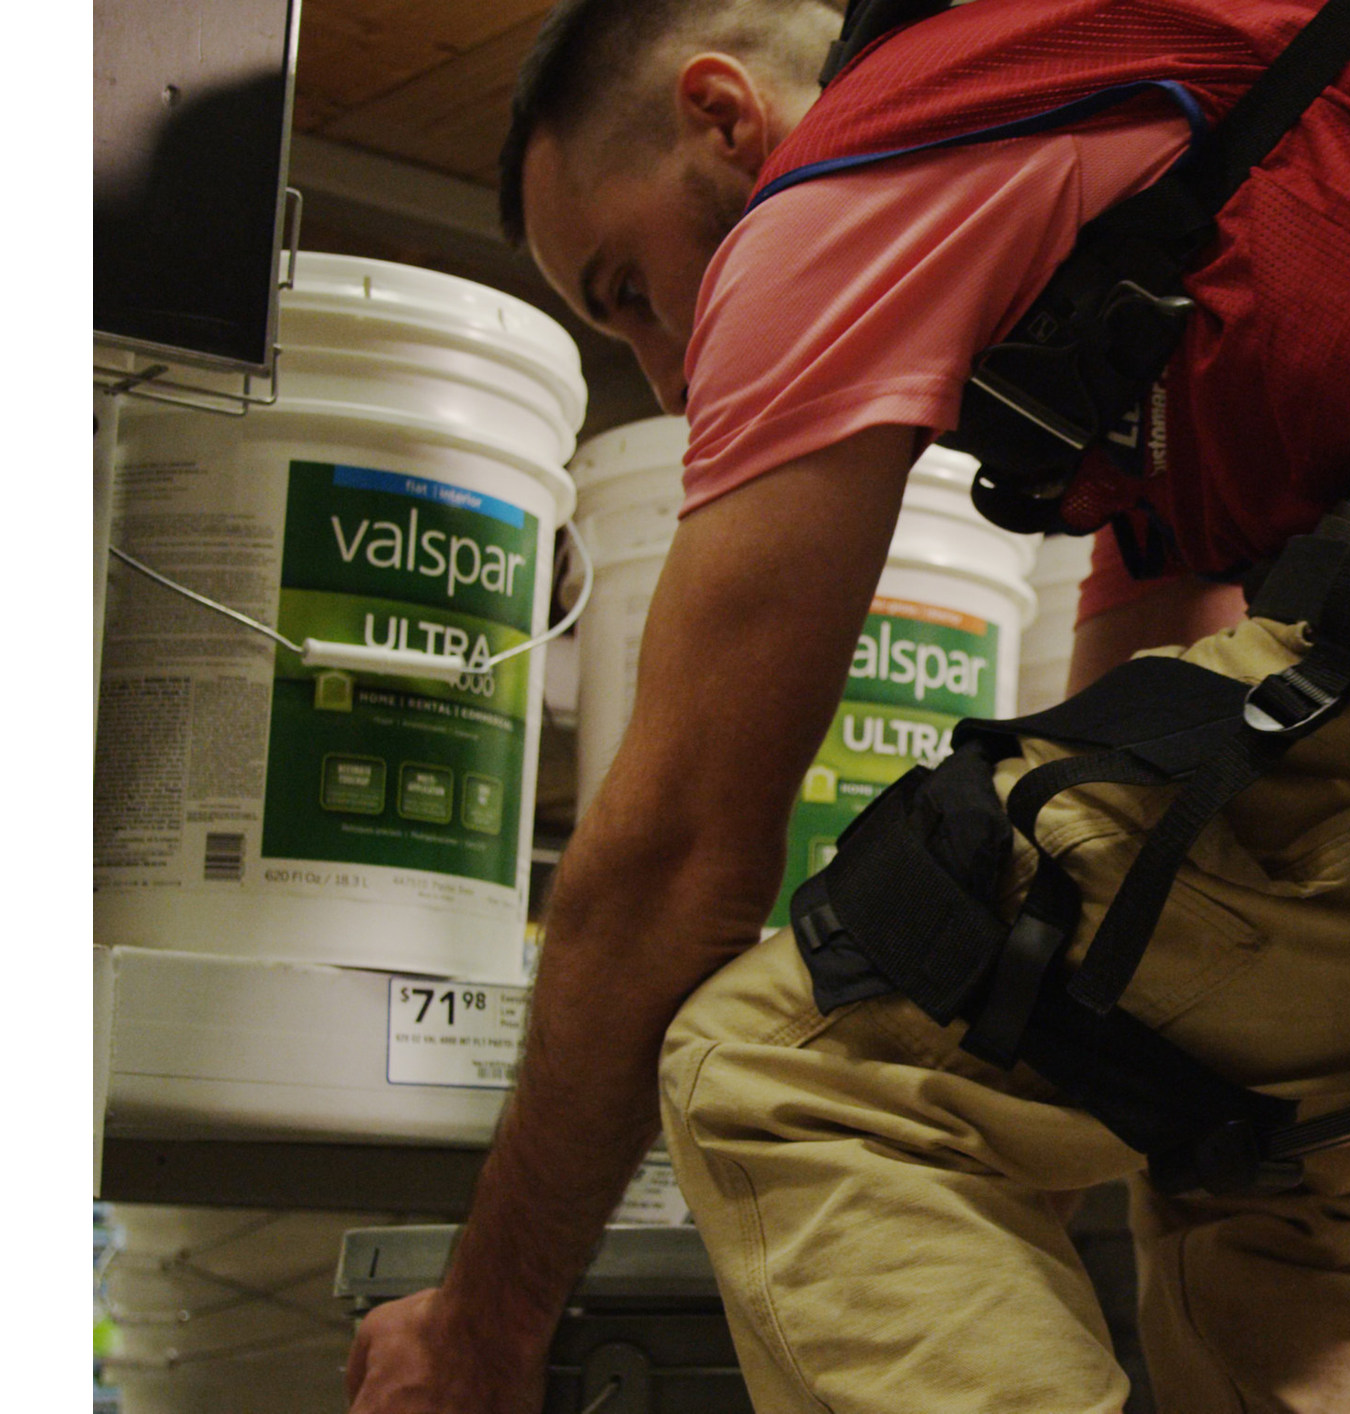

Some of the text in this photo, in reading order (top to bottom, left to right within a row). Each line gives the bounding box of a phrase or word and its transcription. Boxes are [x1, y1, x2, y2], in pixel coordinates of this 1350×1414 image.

[1147, 381, 1167, 477] ustomer
[331, 507, 526, 597] valspar
[364, 613, 493, 672] ULTRA
[451, 668, 496, 698] 000
[849, 620, 988, 701] alspar
